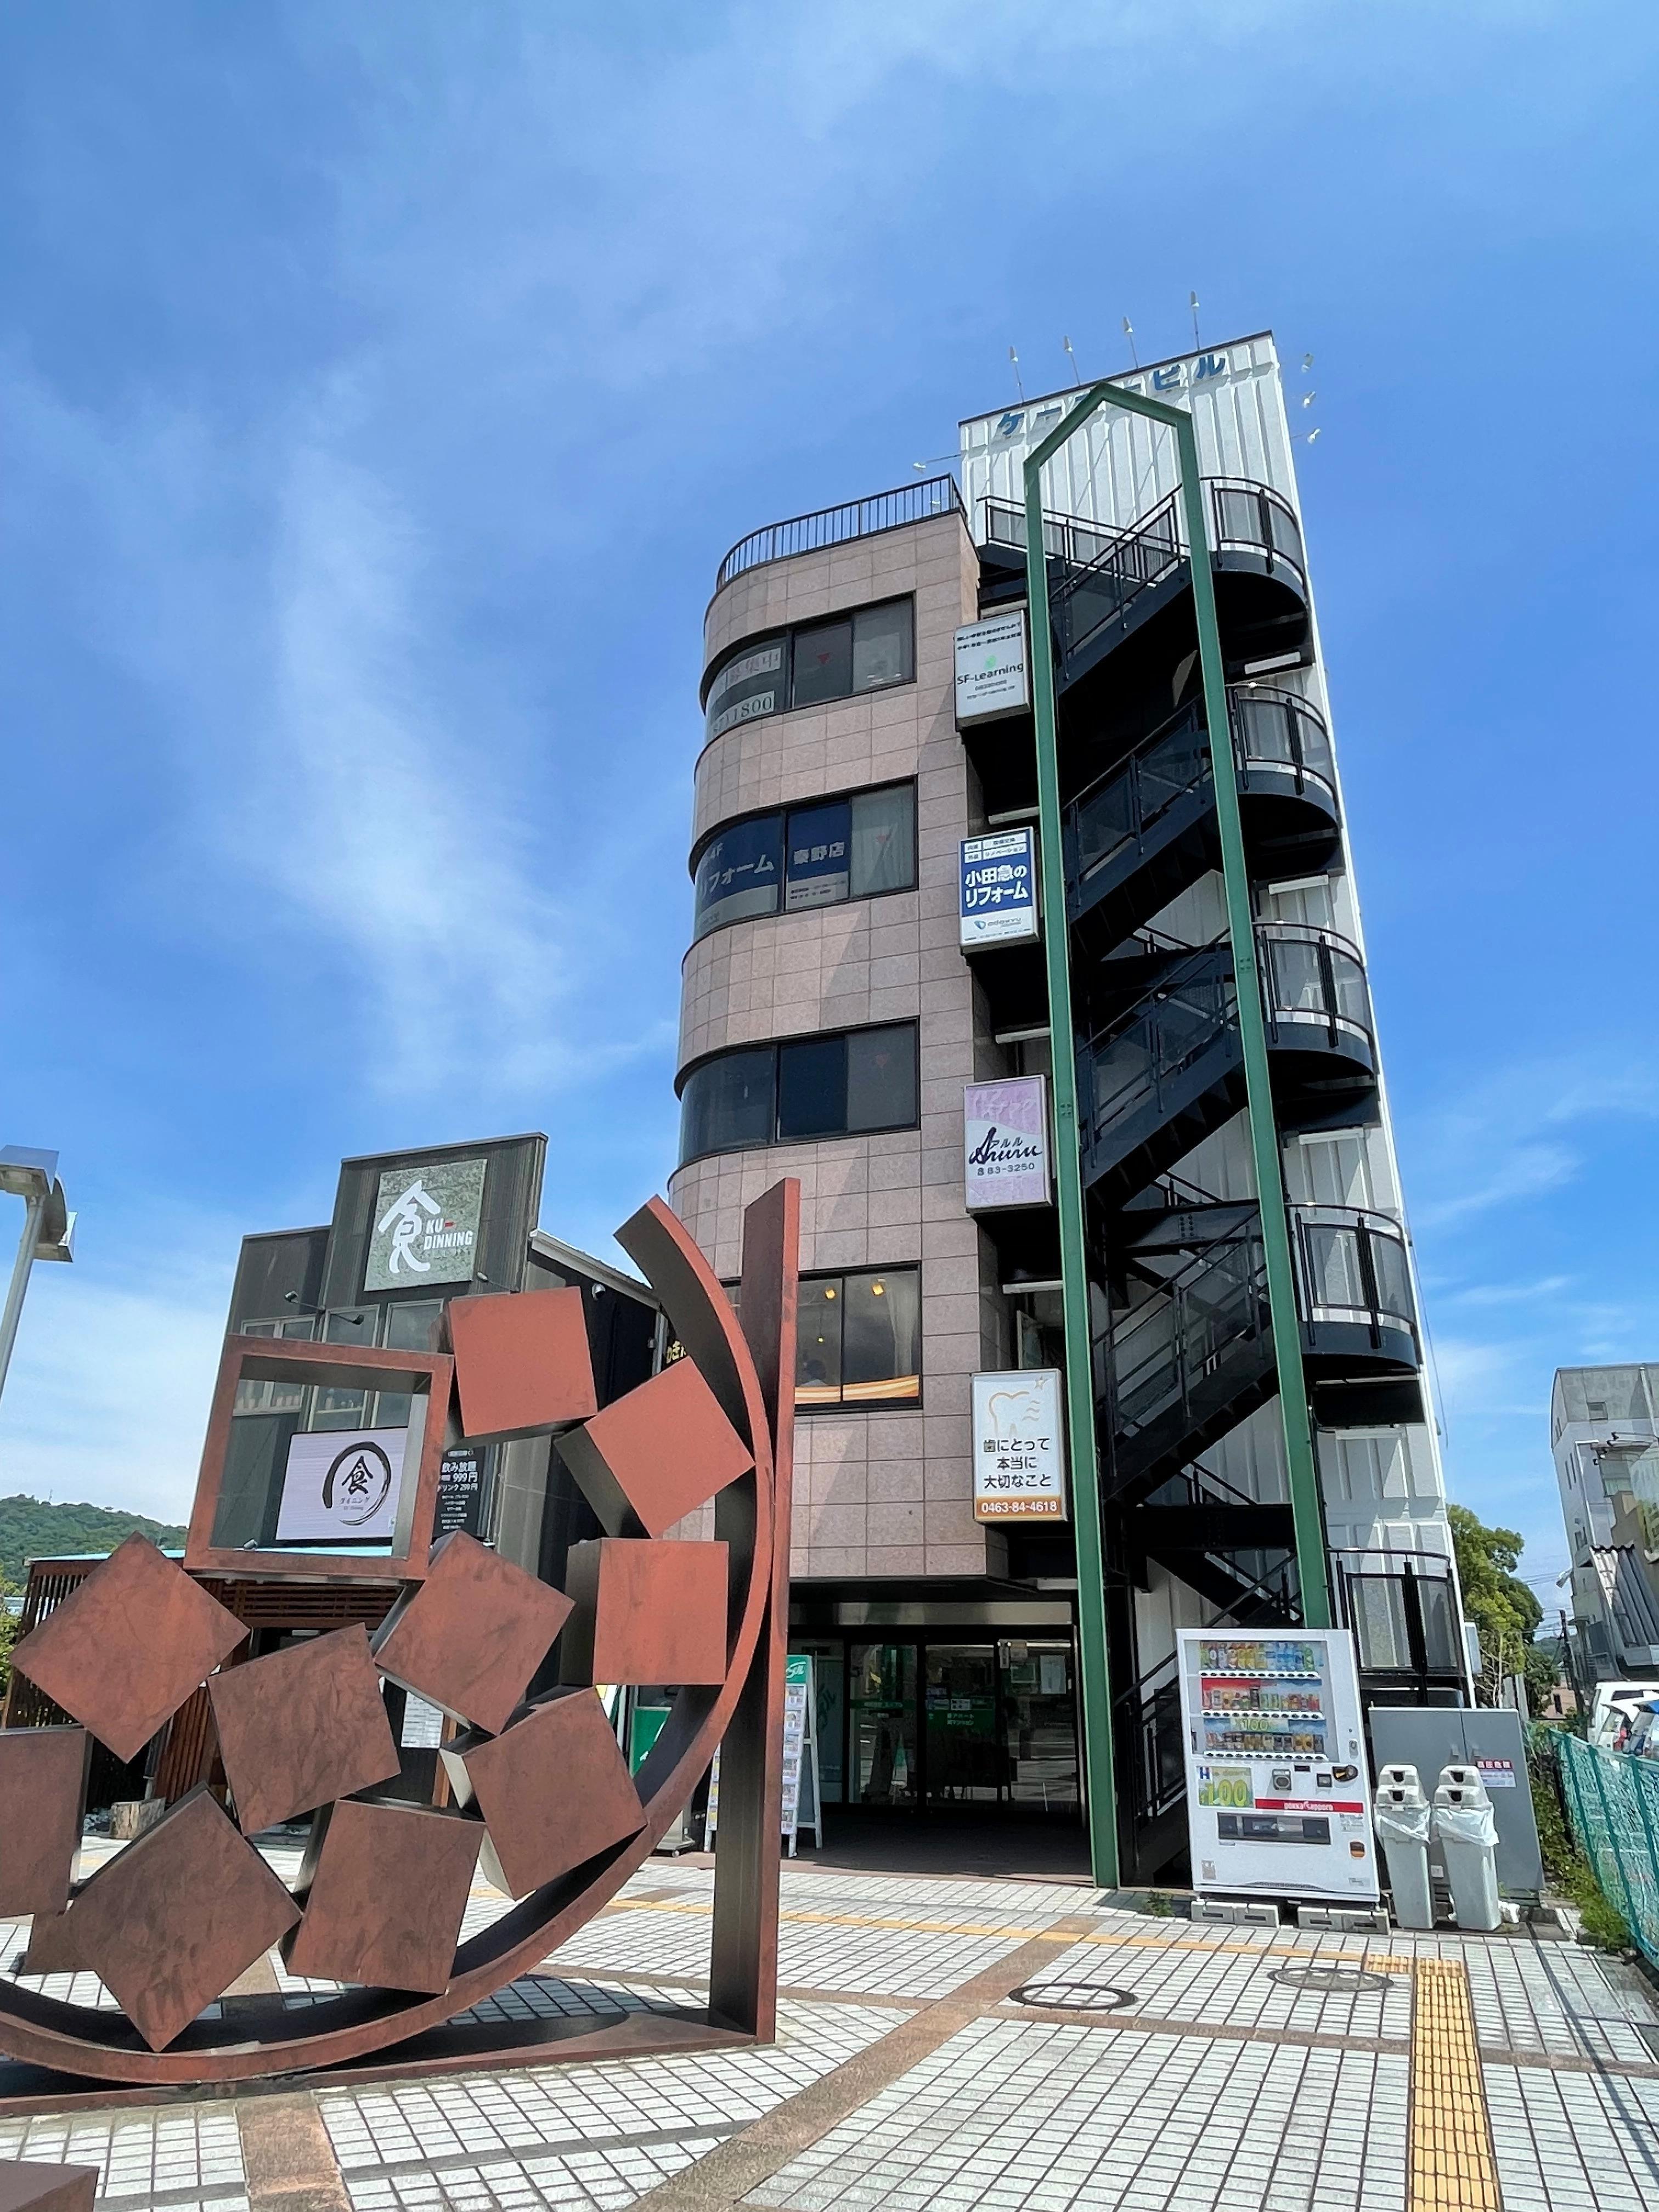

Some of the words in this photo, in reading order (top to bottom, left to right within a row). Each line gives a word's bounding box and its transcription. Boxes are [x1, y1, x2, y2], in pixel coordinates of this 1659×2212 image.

[957, 663, 1024, 685] SF-Learning
[964, 864, 1028, 888] 小田急の
[966, 881, 1029, 909] リフォーム
[424, 1230, 475, 1251] DINNING
[983, 1437, 1050, 1453] 歯にとって
[996, 1455, 1038, 1471] 本当に
[983, 1474, 1052, 1489] 大切なこと
[981, 1500, 1058, 1513] 0463-84-4618
